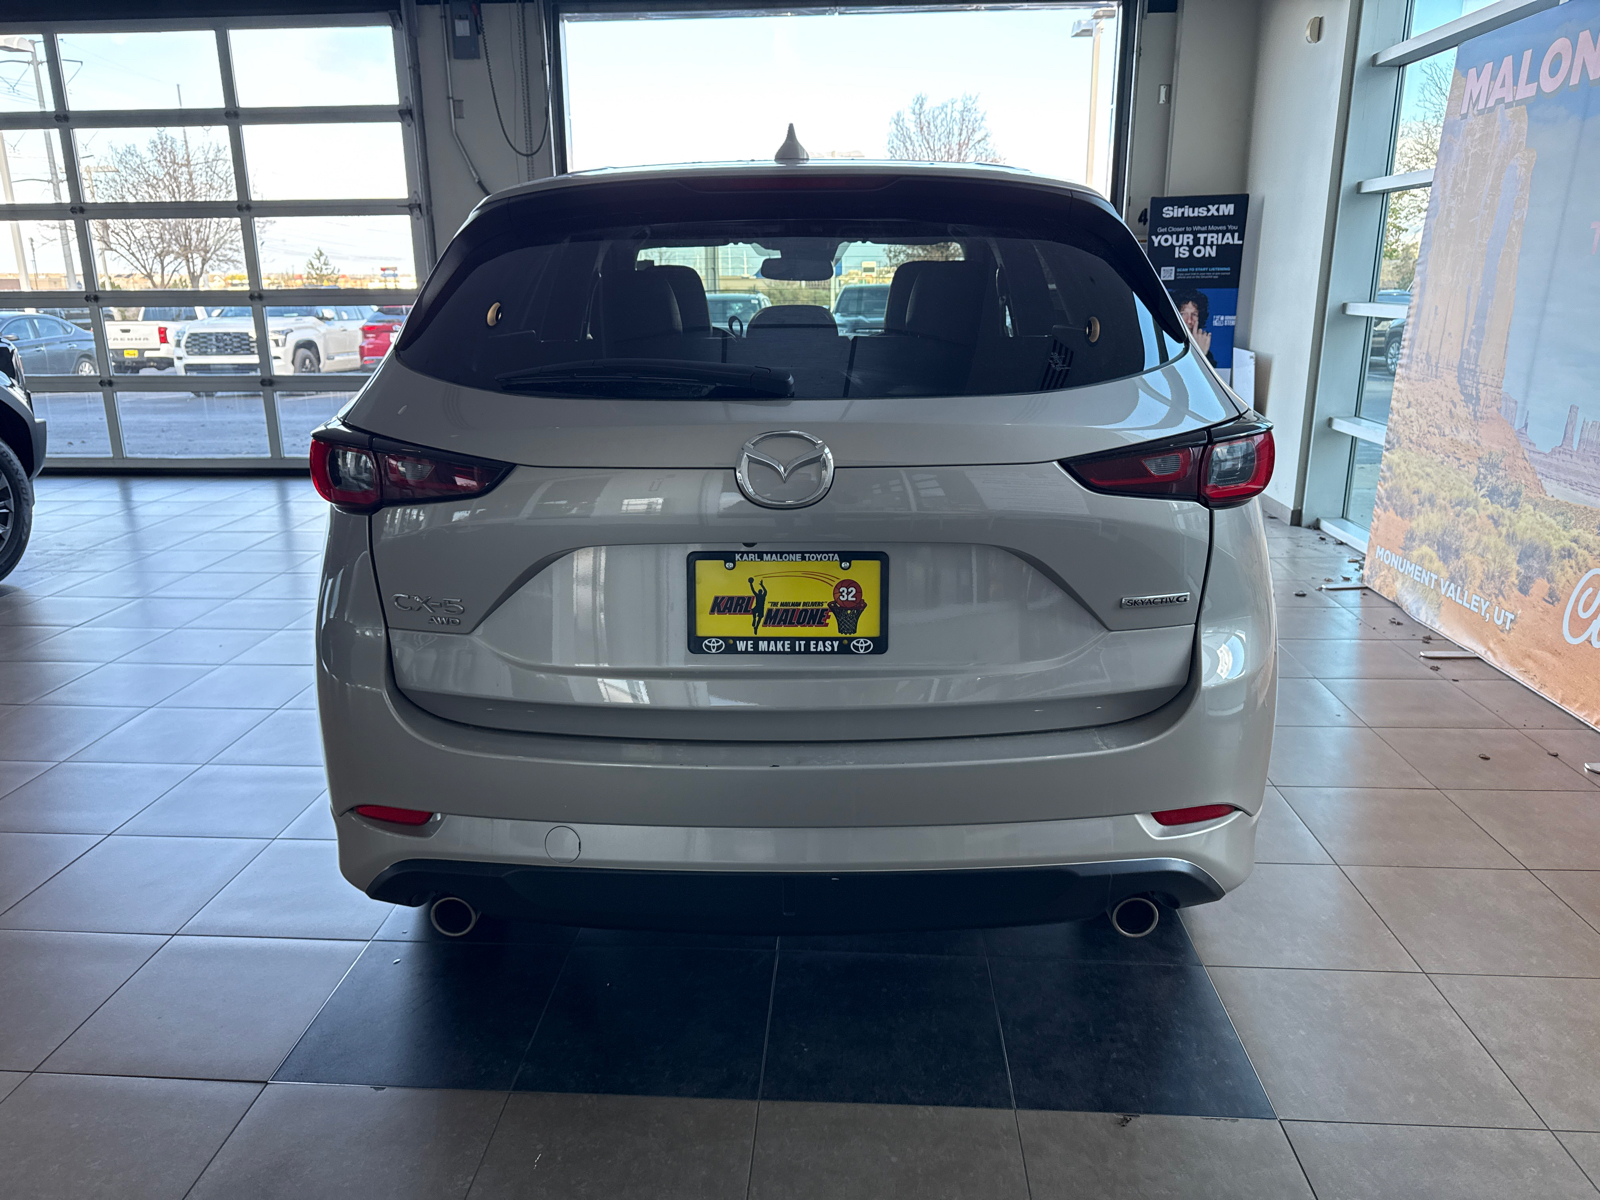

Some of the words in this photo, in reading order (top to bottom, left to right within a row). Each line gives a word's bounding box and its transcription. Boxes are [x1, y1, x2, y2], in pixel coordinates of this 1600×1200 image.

[1138, 208, 1148, 226] 4
[1162, 204, 1234, 218] SiriusXM
[1151, 234, 1193, 247] YOUR
[1197, 232, 1243, 245] TRIAL
[1175, 246, 1189, 258] IS
[1193, 246, 1216, 258] ON
[804, 553, 840, 561] TOYOTA
[839, 587, 857, 601] 32
[1375, 545, 1438, 590] MONUMENT
[1440, 577, 1491, 622] VALLEY,
[1493, 605, 1515, 631] UT
[392, 593, 465, 615] CX-5
[709, 596, 755, 615] KARL
[428, 616, 461, 626] AWD
[762, 607, 831, 627] MALONE
[736, 641, 754, 652] WE
[758, 641, 791, 652] MAKE
[795, 641, 806, 652] IT
[810, 641, 839, 652] EASY
